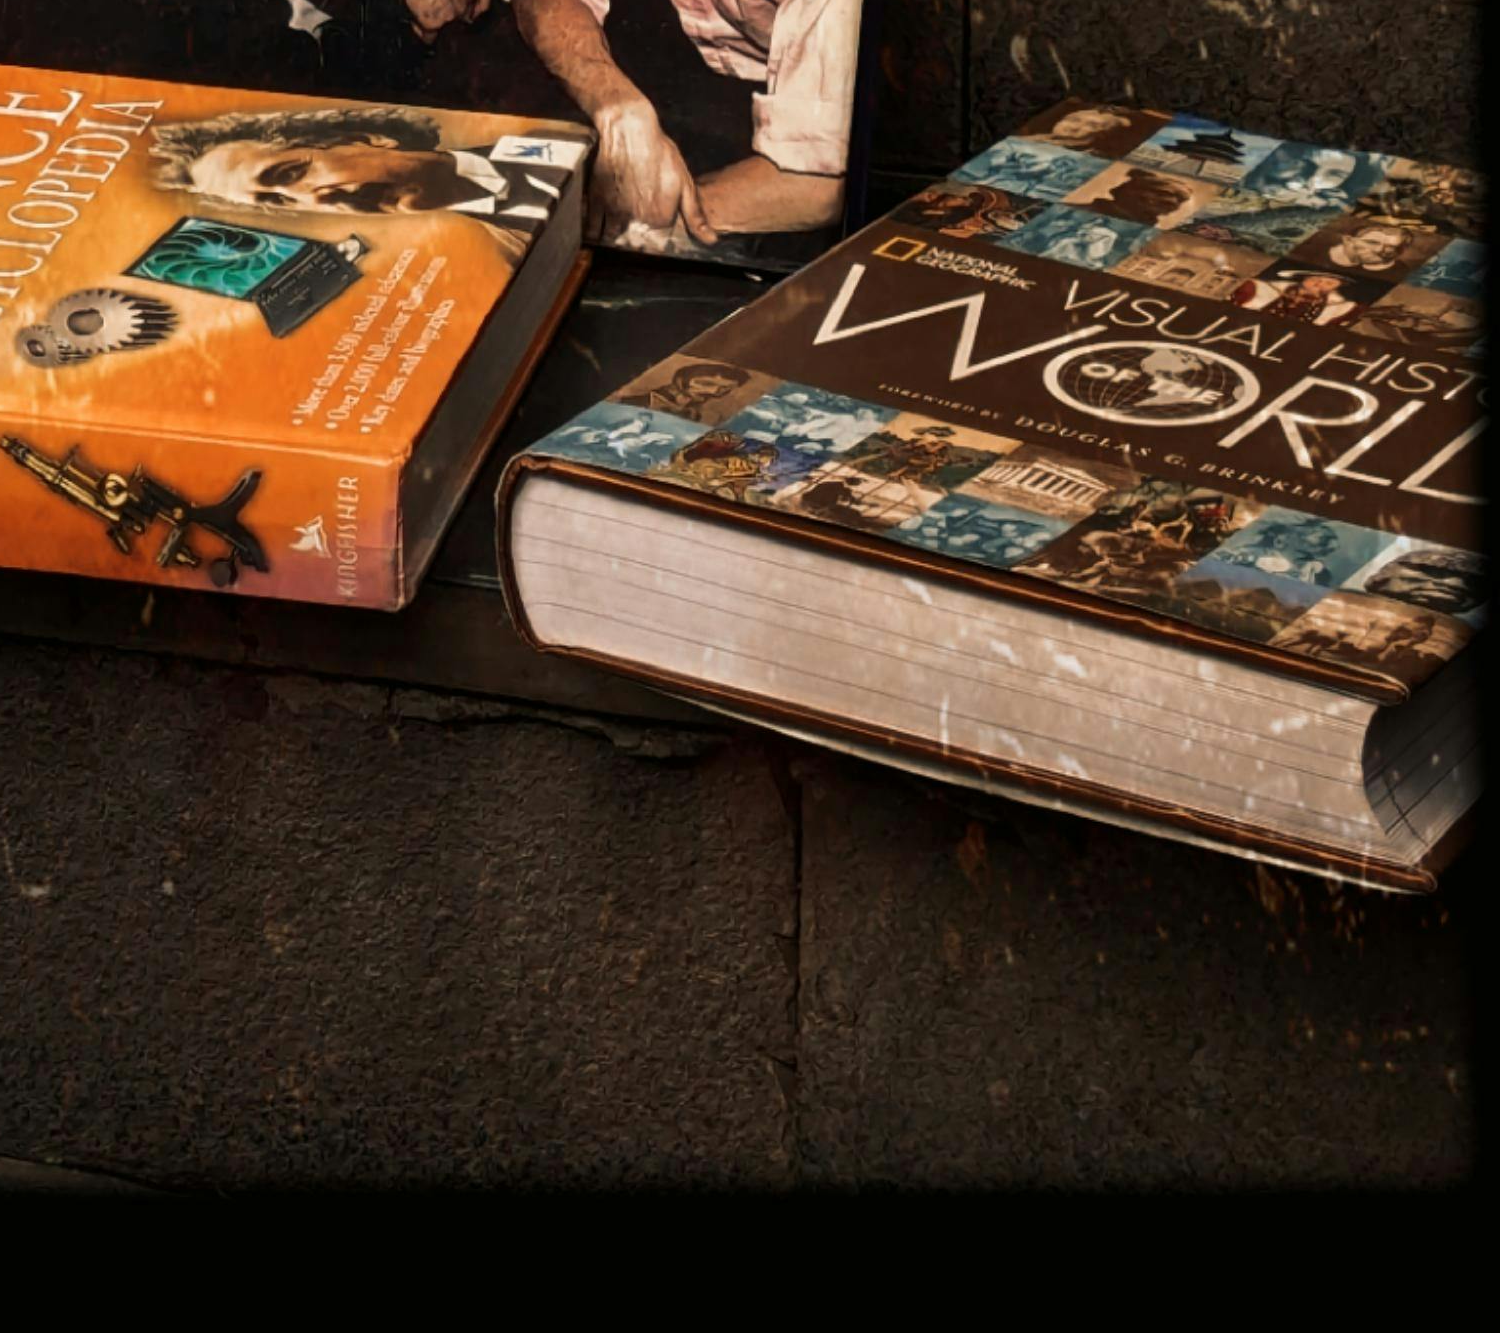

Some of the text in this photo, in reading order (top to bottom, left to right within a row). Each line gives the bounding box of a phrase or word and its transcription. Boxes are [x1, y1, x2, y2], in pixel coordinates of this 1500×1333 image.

[914, 254, 1039, 292] GEOGRAPHIC
[925, 245, 1020, 277] NATIONAL
[1062, 278, 1490, 410] VISUAL HIST
[1080, 361, 1143, 385] OF
[877, 382, 1348, 508] FOREWORD BY DOUGLAS G. BRINKLEY
[336, 475, 360, 599] KINGFISHER
